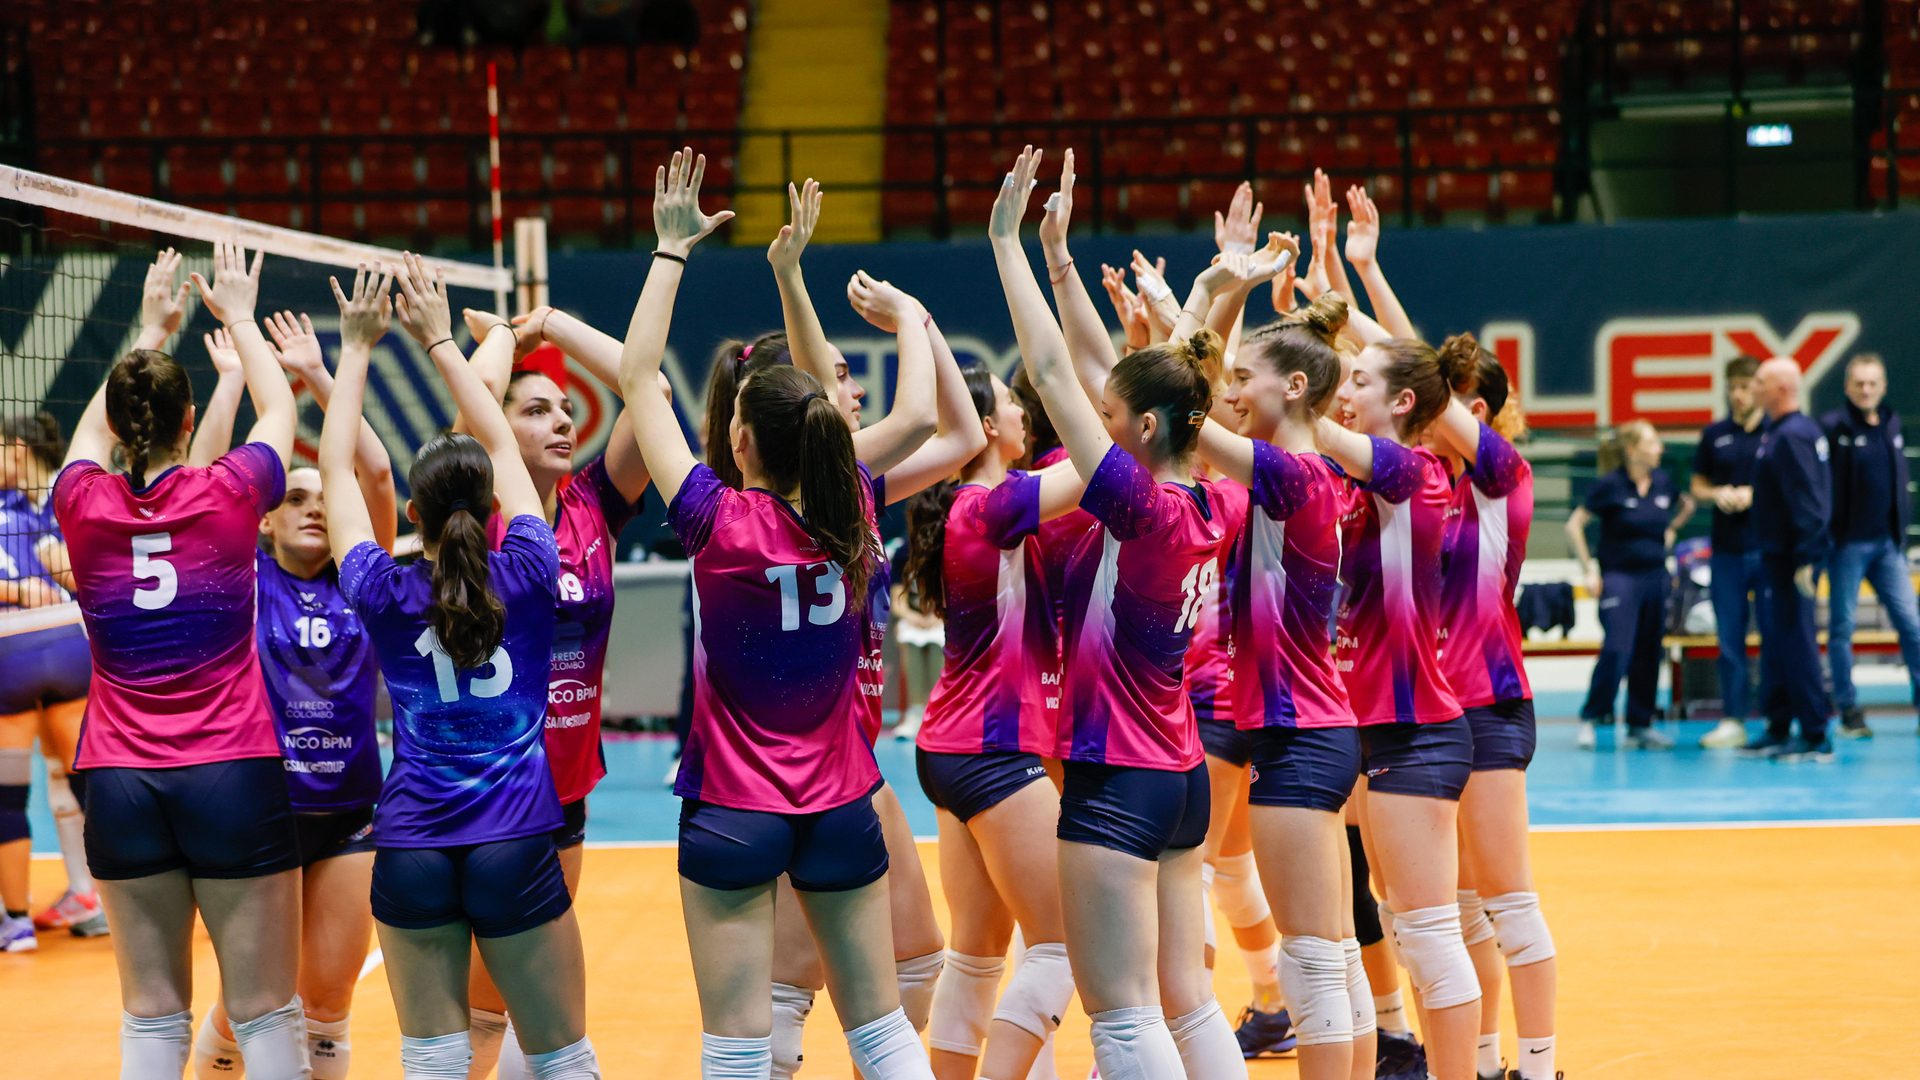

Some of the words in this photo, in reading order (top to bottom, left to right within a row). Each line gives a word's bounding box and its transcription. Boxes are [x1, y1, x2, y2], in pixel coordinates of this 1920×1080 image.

[131, 531, 179, 610] 5
[557, 572, 585, 602] 19
[764, 559, 846, 632] 13
[294, 615, 332, 648] 16
[576, 684, 598, 702] BPM
[285, 710, 335, 719] COLOMBO
[286, 700, 335, 711] ALFREDO
[321, 735, 353, 750] BPM
